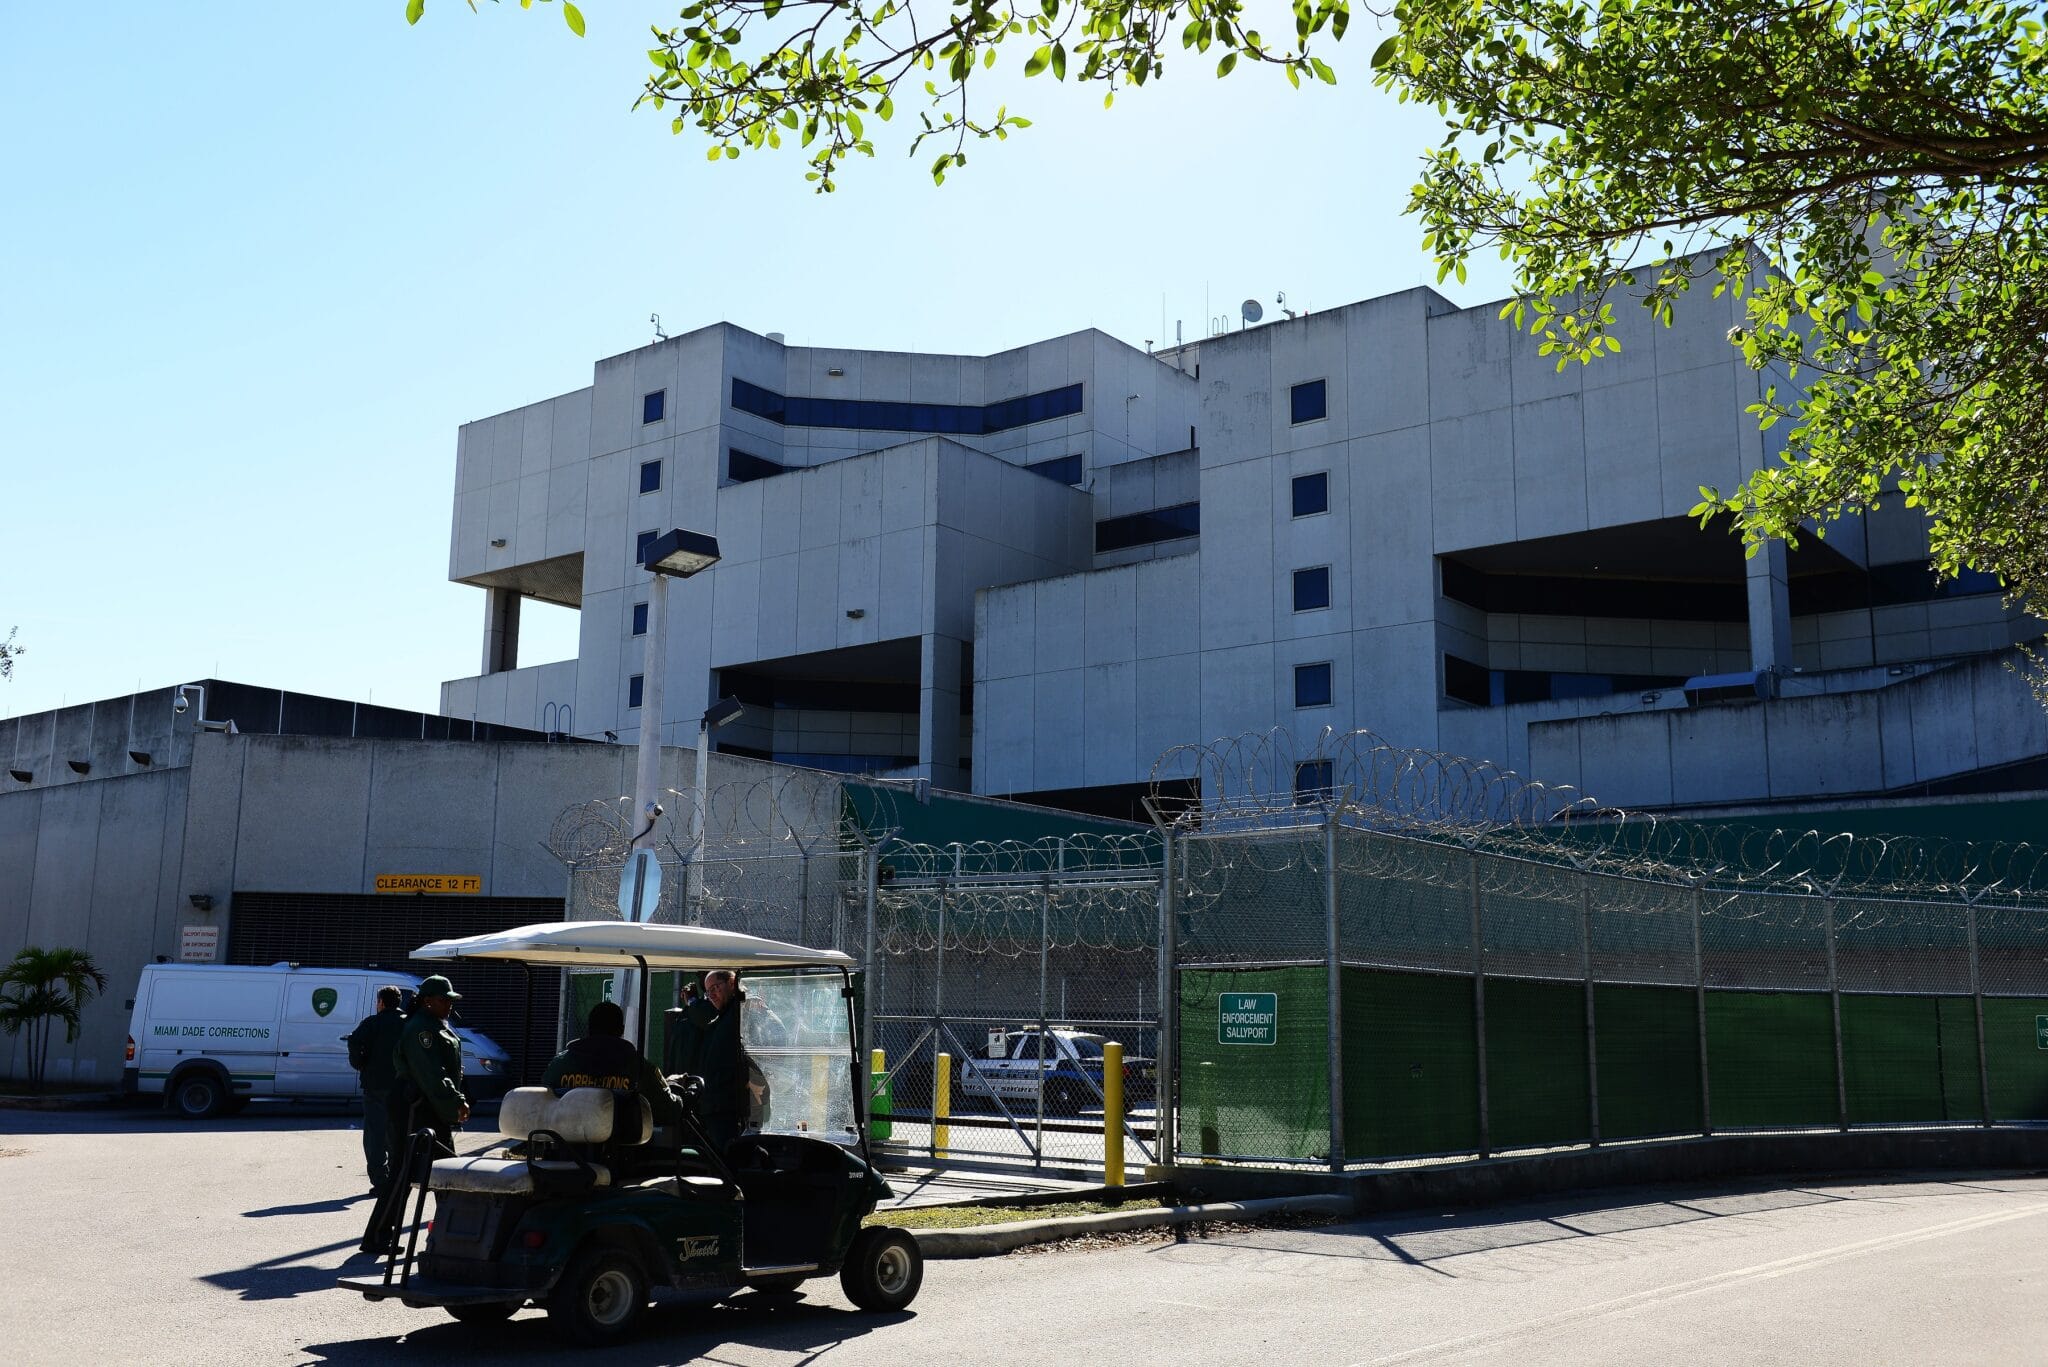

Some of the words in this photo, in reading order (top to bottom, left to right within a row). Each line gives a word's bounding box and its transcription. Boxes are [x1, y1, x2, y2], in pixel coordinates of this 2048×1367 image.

[376, 878, 442, 889] CLEARANCE
[447, 879, 458, 889] 12
[463, 879, 480, 889] FT.
[1238, 999, 1257, 1010] LAW
[1222, 1013, 1274, 1024] ENFORCEMENT
[153, 1026, 180, 1037] MIAMI
[182, 1026, 206, 1037] DADE
[208, 1027, 270, 1039] CORRECTIONS
[1226, 1027, 1269, 1039] SALLYPORT
